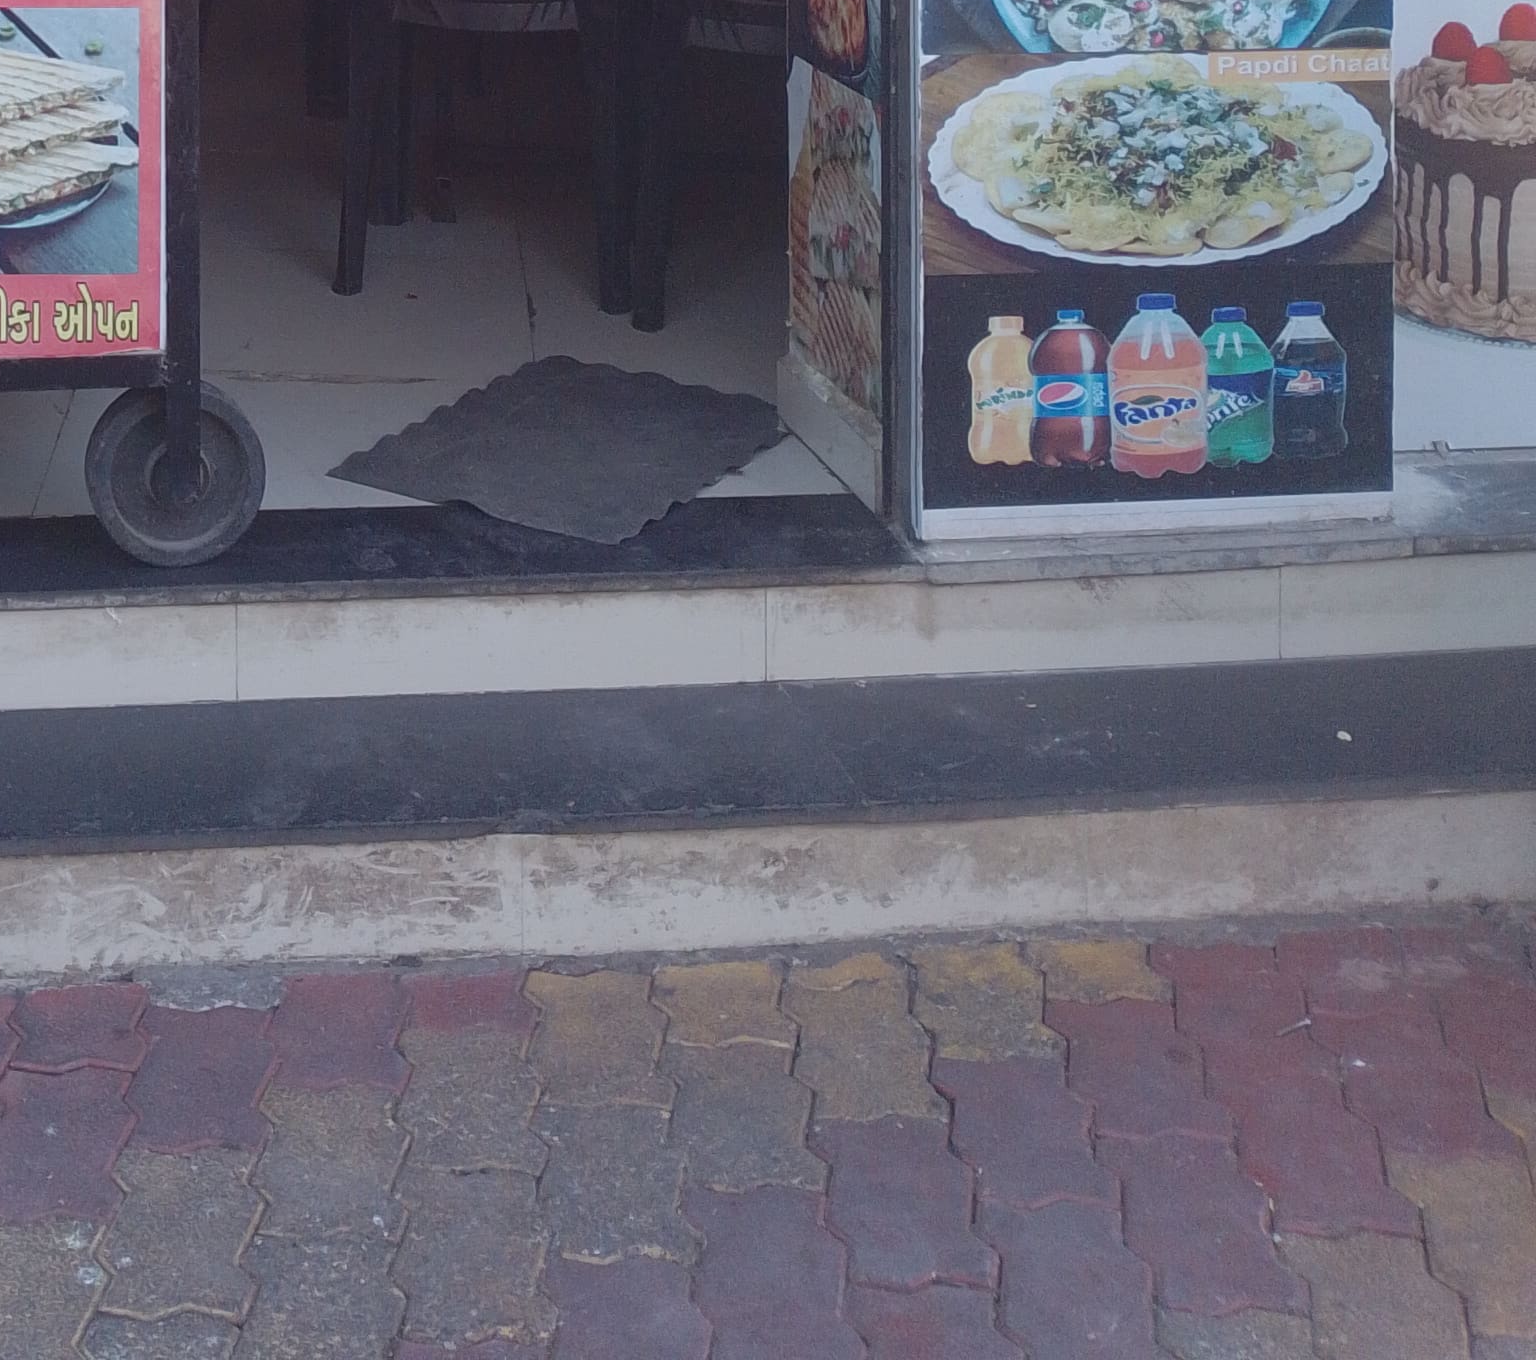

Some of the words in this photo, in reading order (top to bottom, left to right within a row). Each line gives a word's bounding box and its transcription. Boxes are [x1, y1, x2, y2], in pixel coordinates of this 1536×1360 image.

[1217, 54, 1298, 77] Papdi
[1307, 53, 1390, 75] Chaat
[53, 282, 139, 343] ઓપન
[1114, 396, 1198, 427] Fanta
